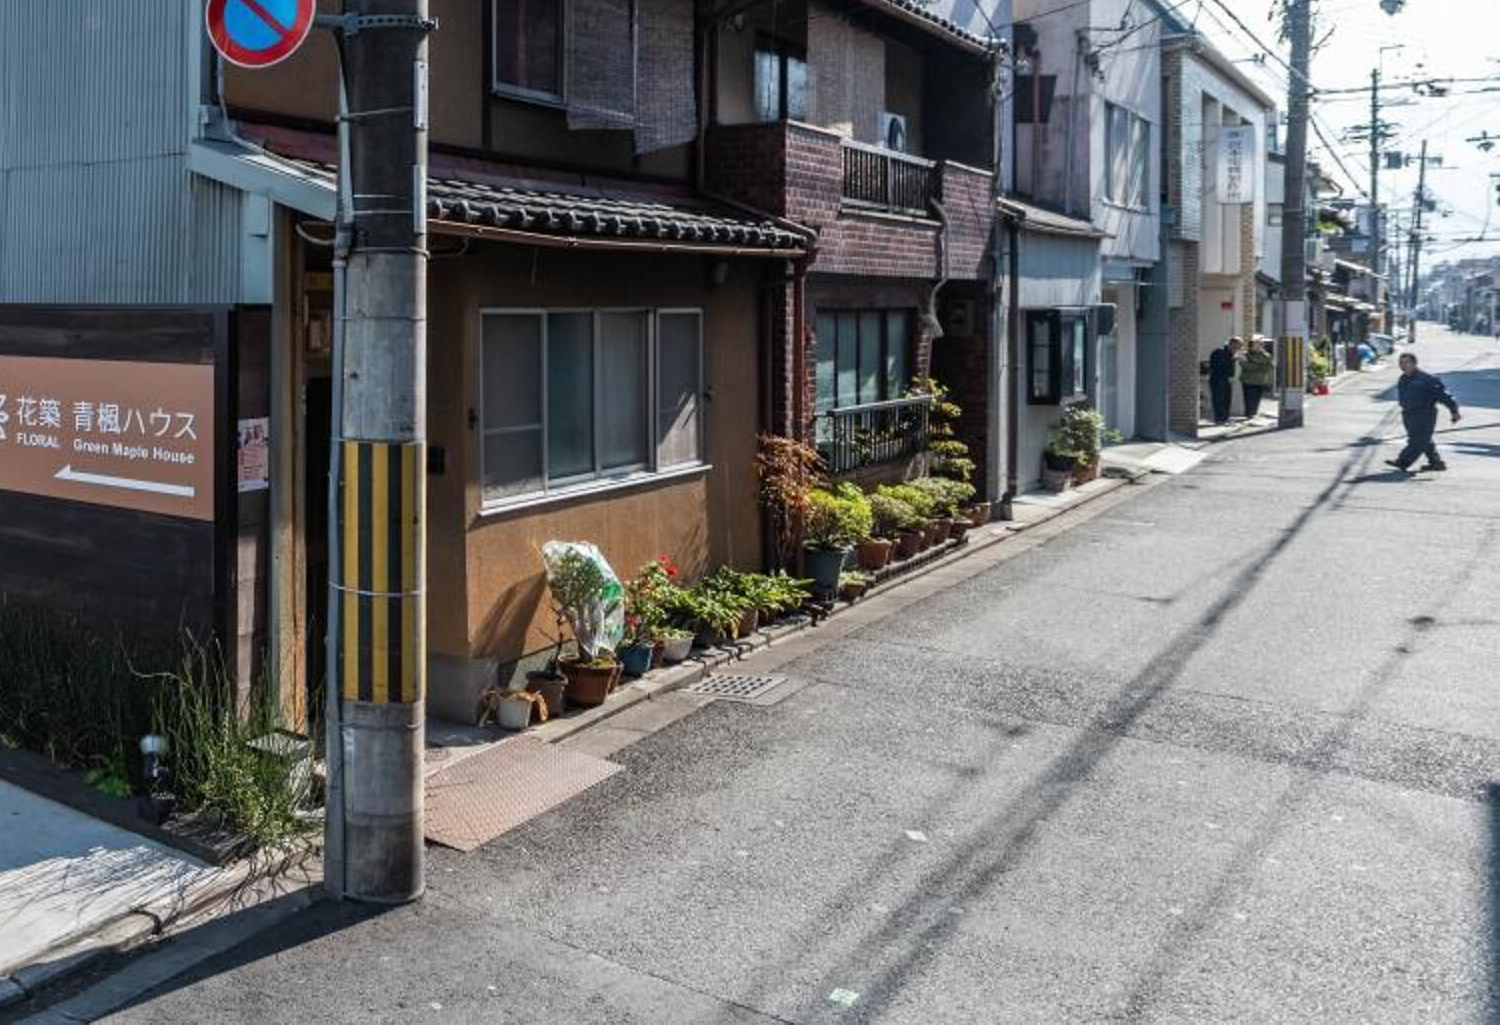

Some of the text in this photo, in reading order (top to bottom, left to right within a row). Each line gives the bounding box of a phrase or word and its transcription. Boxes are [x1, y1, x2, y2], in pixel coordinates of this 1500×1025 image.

[15, 395, 197, 440] 花築 青楓ハウス
[16, 432, 196, 464] FLORAL Green Maple House
